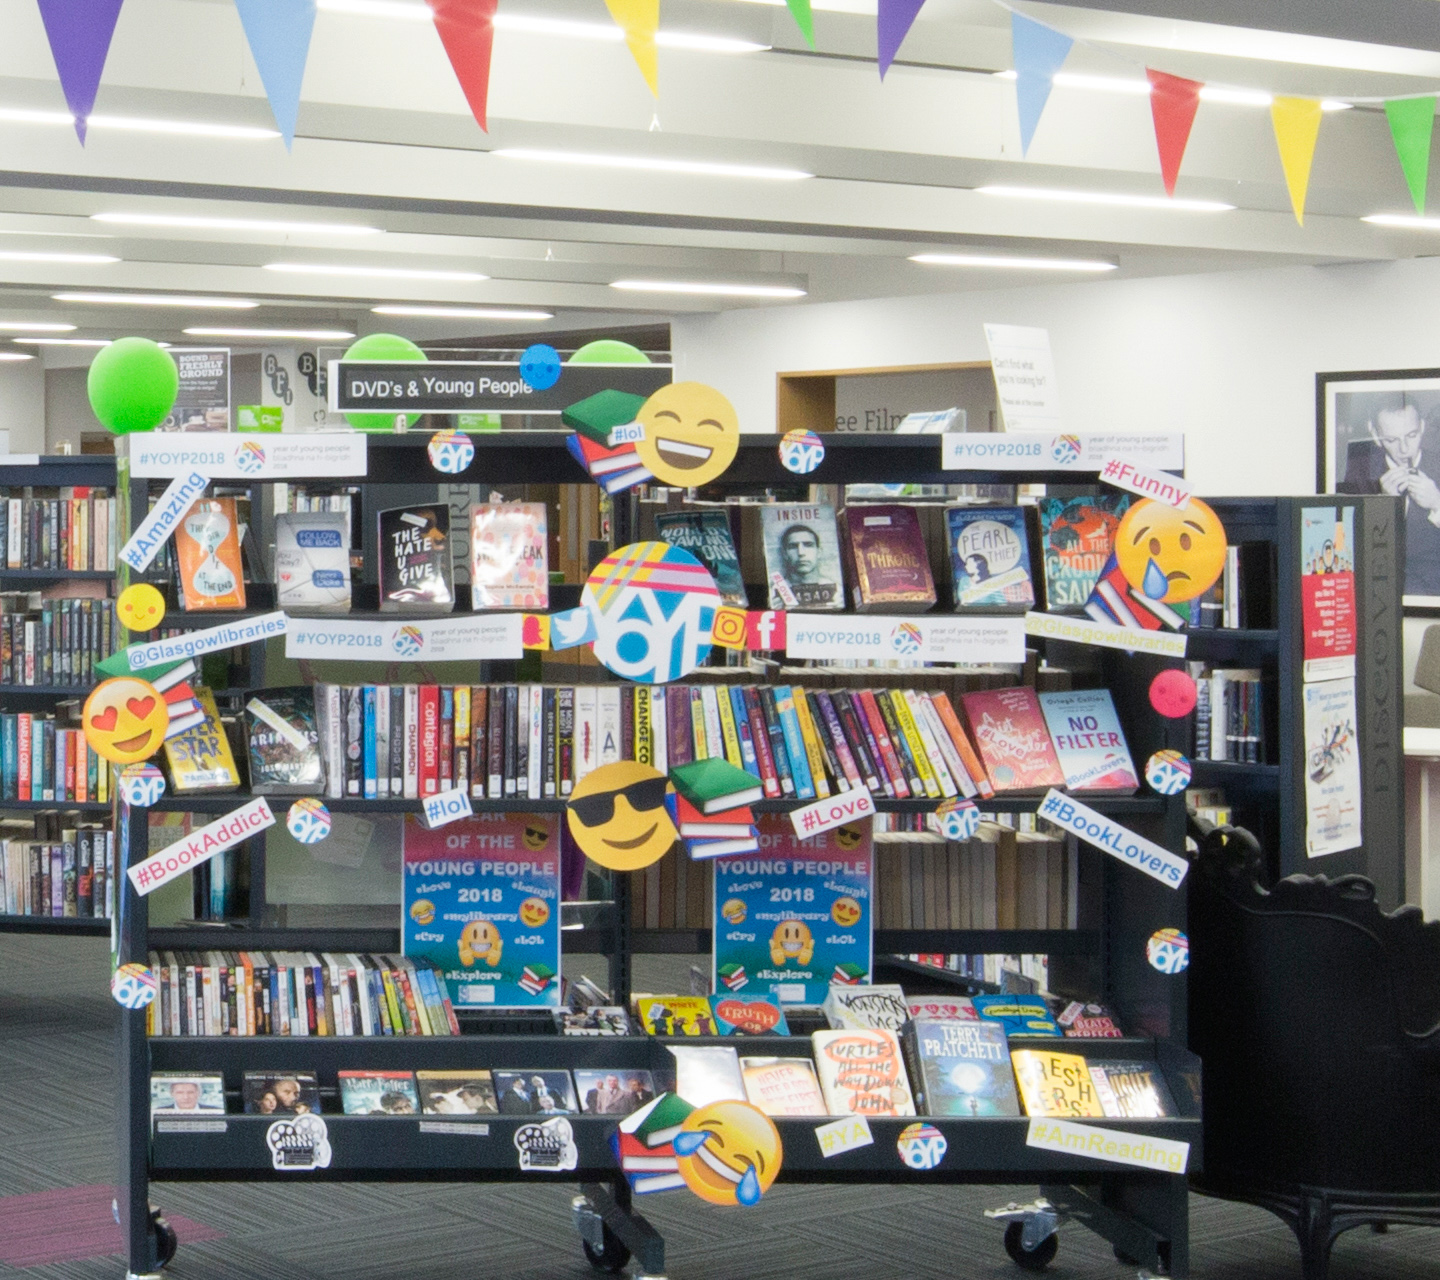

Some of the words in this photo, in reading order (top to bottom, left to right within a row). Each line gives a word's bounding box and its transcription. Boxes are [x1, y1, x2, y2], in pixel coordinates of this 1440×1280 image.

[179, 360, 224, 370] FRESHLY
[179, 368, 224, 378] GROUND
[351, 380, 403, 398] DVD's
[407, 380, 420, 397] &
[423, 376, 474, 398] Young
[478, 376, 533, 397] People
[614, 426, 643, 442] #lol
[139, 452, 225, 465] #YOYP2018
[953, 443, 1042, 457] #YOYP2018
[1103, 458, 1188, 507] #Funny
[127, 471, 207, 568] #Amazing
[776, 507, 821, 521] INSIDE
[299, 530, 339, 541] FOLLOW
[313, 537, 341, 548] BACK
[392, 526, 420, 545] THE
[666, 535, 703, 548] SAW
[705, 535, 728, 546] NO
[962, 527, 1015, 554] PEARL
[394, 537, 432, 557] HATE
[701, 544, 736, 561] ONE
[1066, 539, 1085, 553] ALL
[1089, 537, 1109, 553] THE
[397, 556, 407, 569] U
[867, 552, 920, 569] THRONE
[987, 546, 1018, 564] THIEF
[399, 562, 434, 586] GIVE
[217, 581, 233, 592] END
[772, 572, 793, 603] #Love
[129, 617, 286, 669] @Glasgowlibraries
[295, 632, 383, 647] #YOYP2018
[795, 631, 881, 645] #YOYP2018
[1024, 616, 1185, 653] @Glasgowlibraries
[639, 688, 649, 743] CHANGE
[423, 701, 437, 767] contagion
[828, 720, 847, 746] LOVE
[1068, 716, 1099, 734] NO
[19, 718, 28, 753] HARLAN
[981, 726, 1025, 757] #Love
[1055, 730, 1123, 752] FILTER
[172, 740, 222, 761] STAR
[408, 724, 417, 776] CHAMPION
[19, 753, 28, 781] COBEN
[426, 793, 470, 821] #lol
[801, 796, 870, 831] #Love
[446, 835, 471, 850] OF
[476, 835, 515, 850] THE
[789, 835, 827, 849] THE
[1042, 796, 1183, 883] #BookLovers
[135, 809, 271, 890] #BookAddict
[406, 861, 476, 877] YOUNG
[480, 861, 555, 877] PEOPLE
[719, 861, 787, 876] YOUNG
[792, 861, 867, 876] PEOPLE
[457, 888, 503, 903] 2018
[769, 887, 815, 902] 2018
[669, 1001, 698, 1010] WHITE
[721, 1006, 775, 1025] TRUTH
[1077, 1019, 1110, 1029] BEATS
[743, 1020, 763, 1033] OR
[940, 1025, 982, 1043] TERRY
[825, 1039, 895, 1061] TURTLES
[923, 1040, 1002, 1061] PRATCHETT
[838, 1059, 858, 1074] ALL
[867, 1059, 893, 1074] THE
[378, 1078, 411, 1091] Potter
[757, 1067, 795, 1085] NEVER
[833, 1073, 859, 1089] WAY
[862, 1074, 905, 1090] DOWN
[849, 1090, 895, 1113] JOHN
[820, 1121, 870, 1151] #YA
[1031, 1122, 1184, 1172] #AmReading
